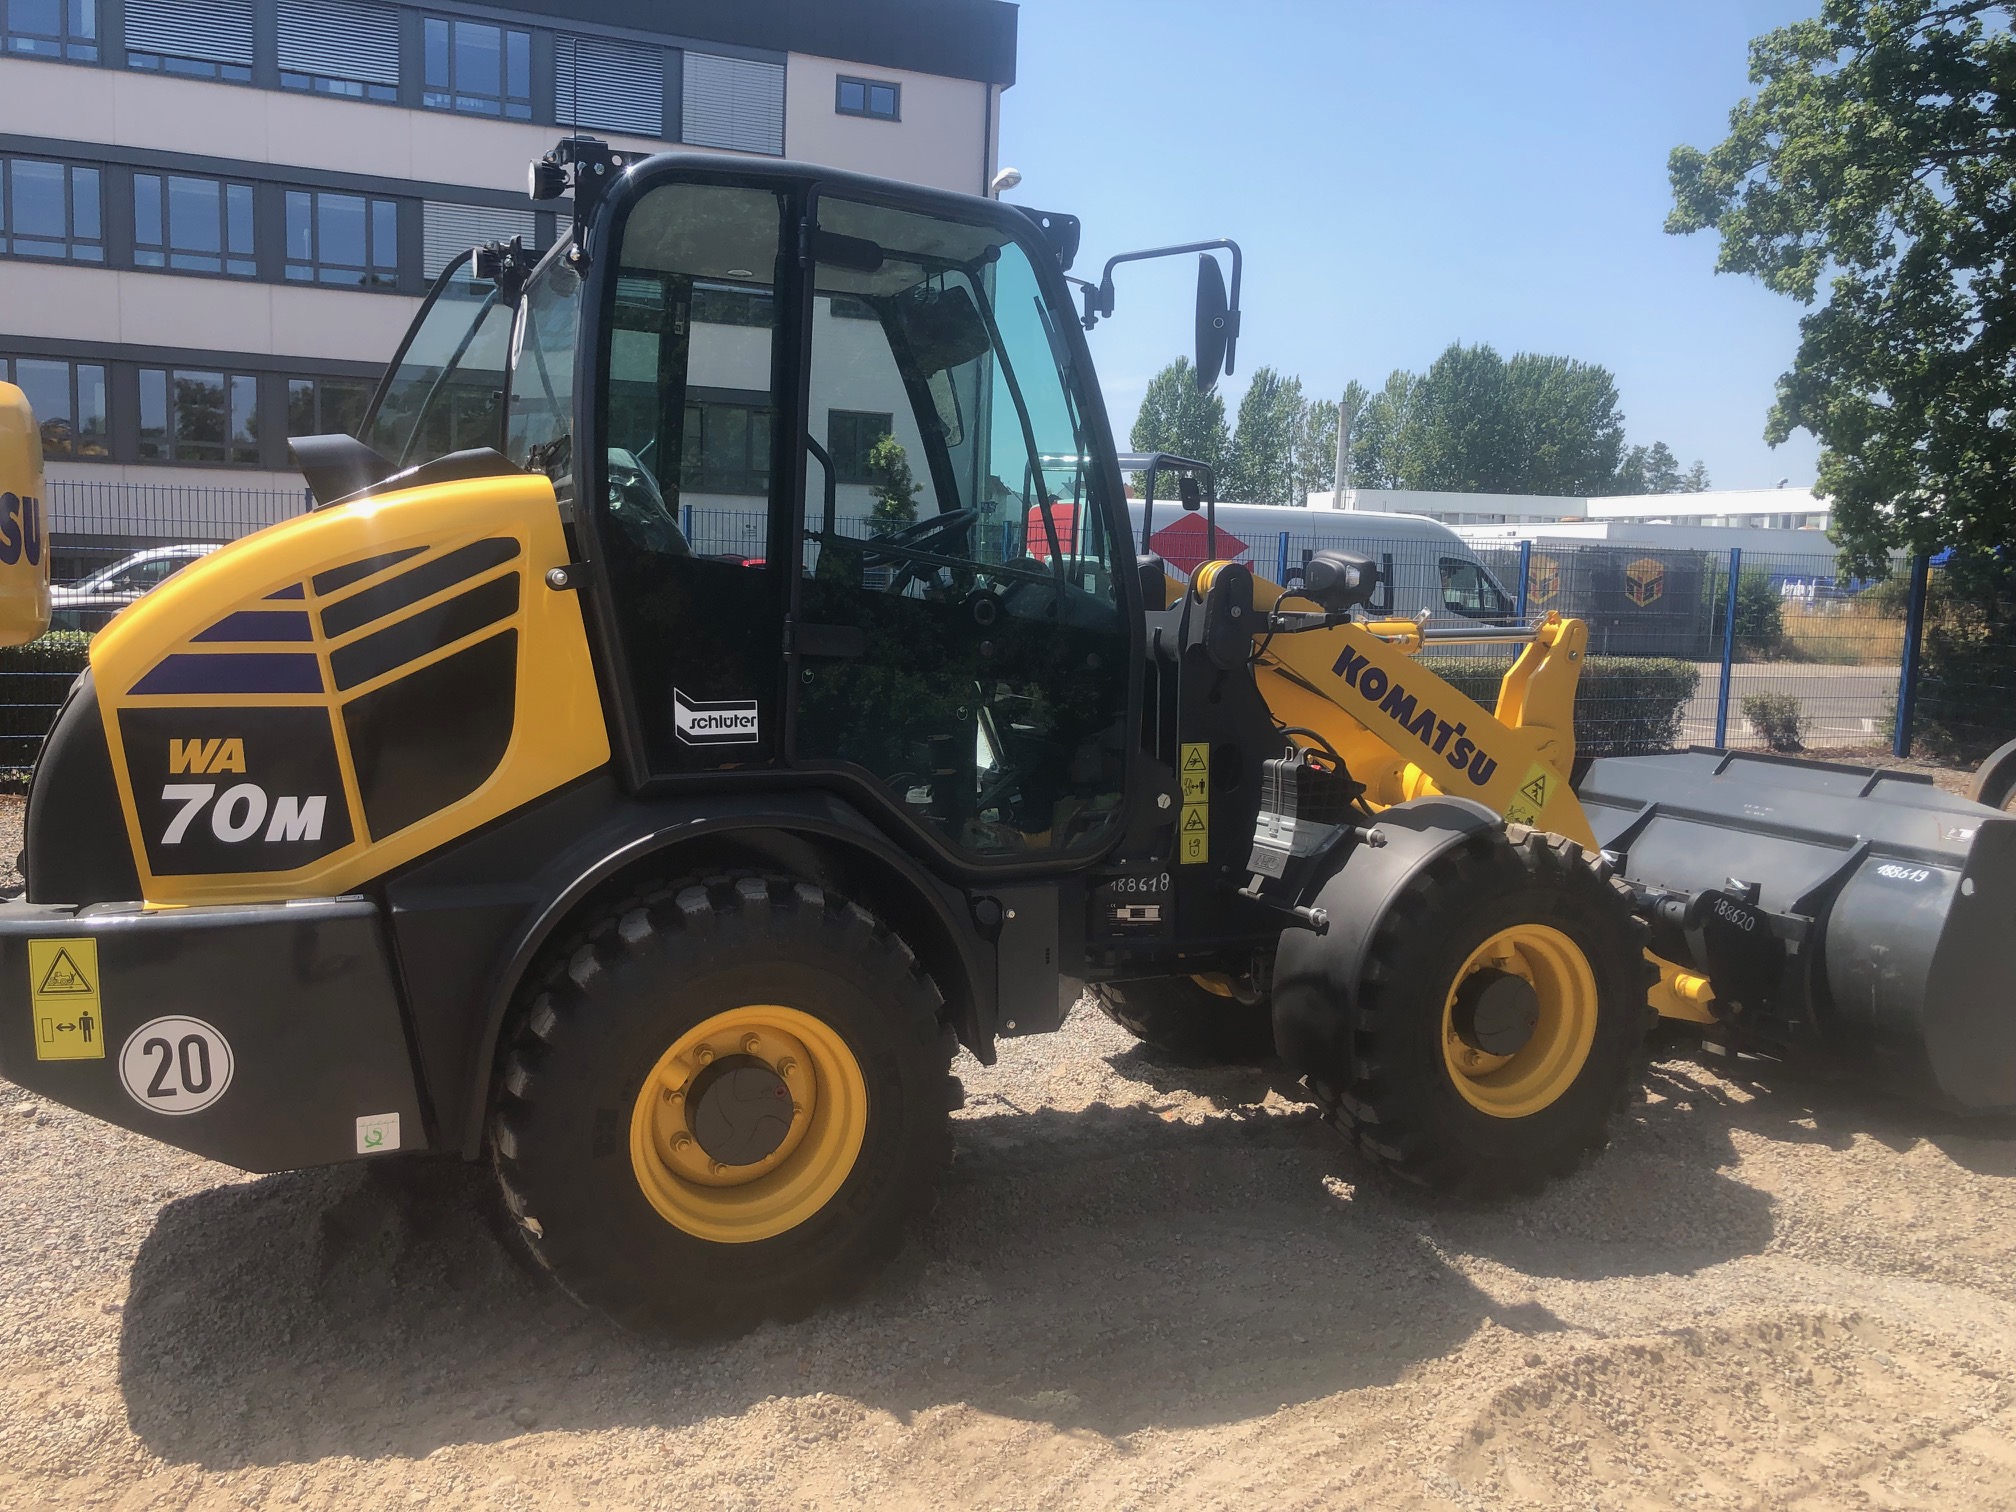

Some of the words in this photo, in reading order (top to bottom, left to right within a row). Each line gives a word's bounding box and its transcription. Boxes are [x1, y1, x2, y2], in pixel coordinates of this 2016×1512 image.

[689, 714, 757, 730] schlüter
[1331, 644, 1498, 786] KOMATSU
[169, 738, 246, 774] WA
[161, 783, 327, 845] 70M
[1110, 872, 1170, 893] 188618
[1876, 864, 1930, 883] 188619
[1713, 898, 1756, 932] 188620
[142, 1034, 212, 1098] 20
